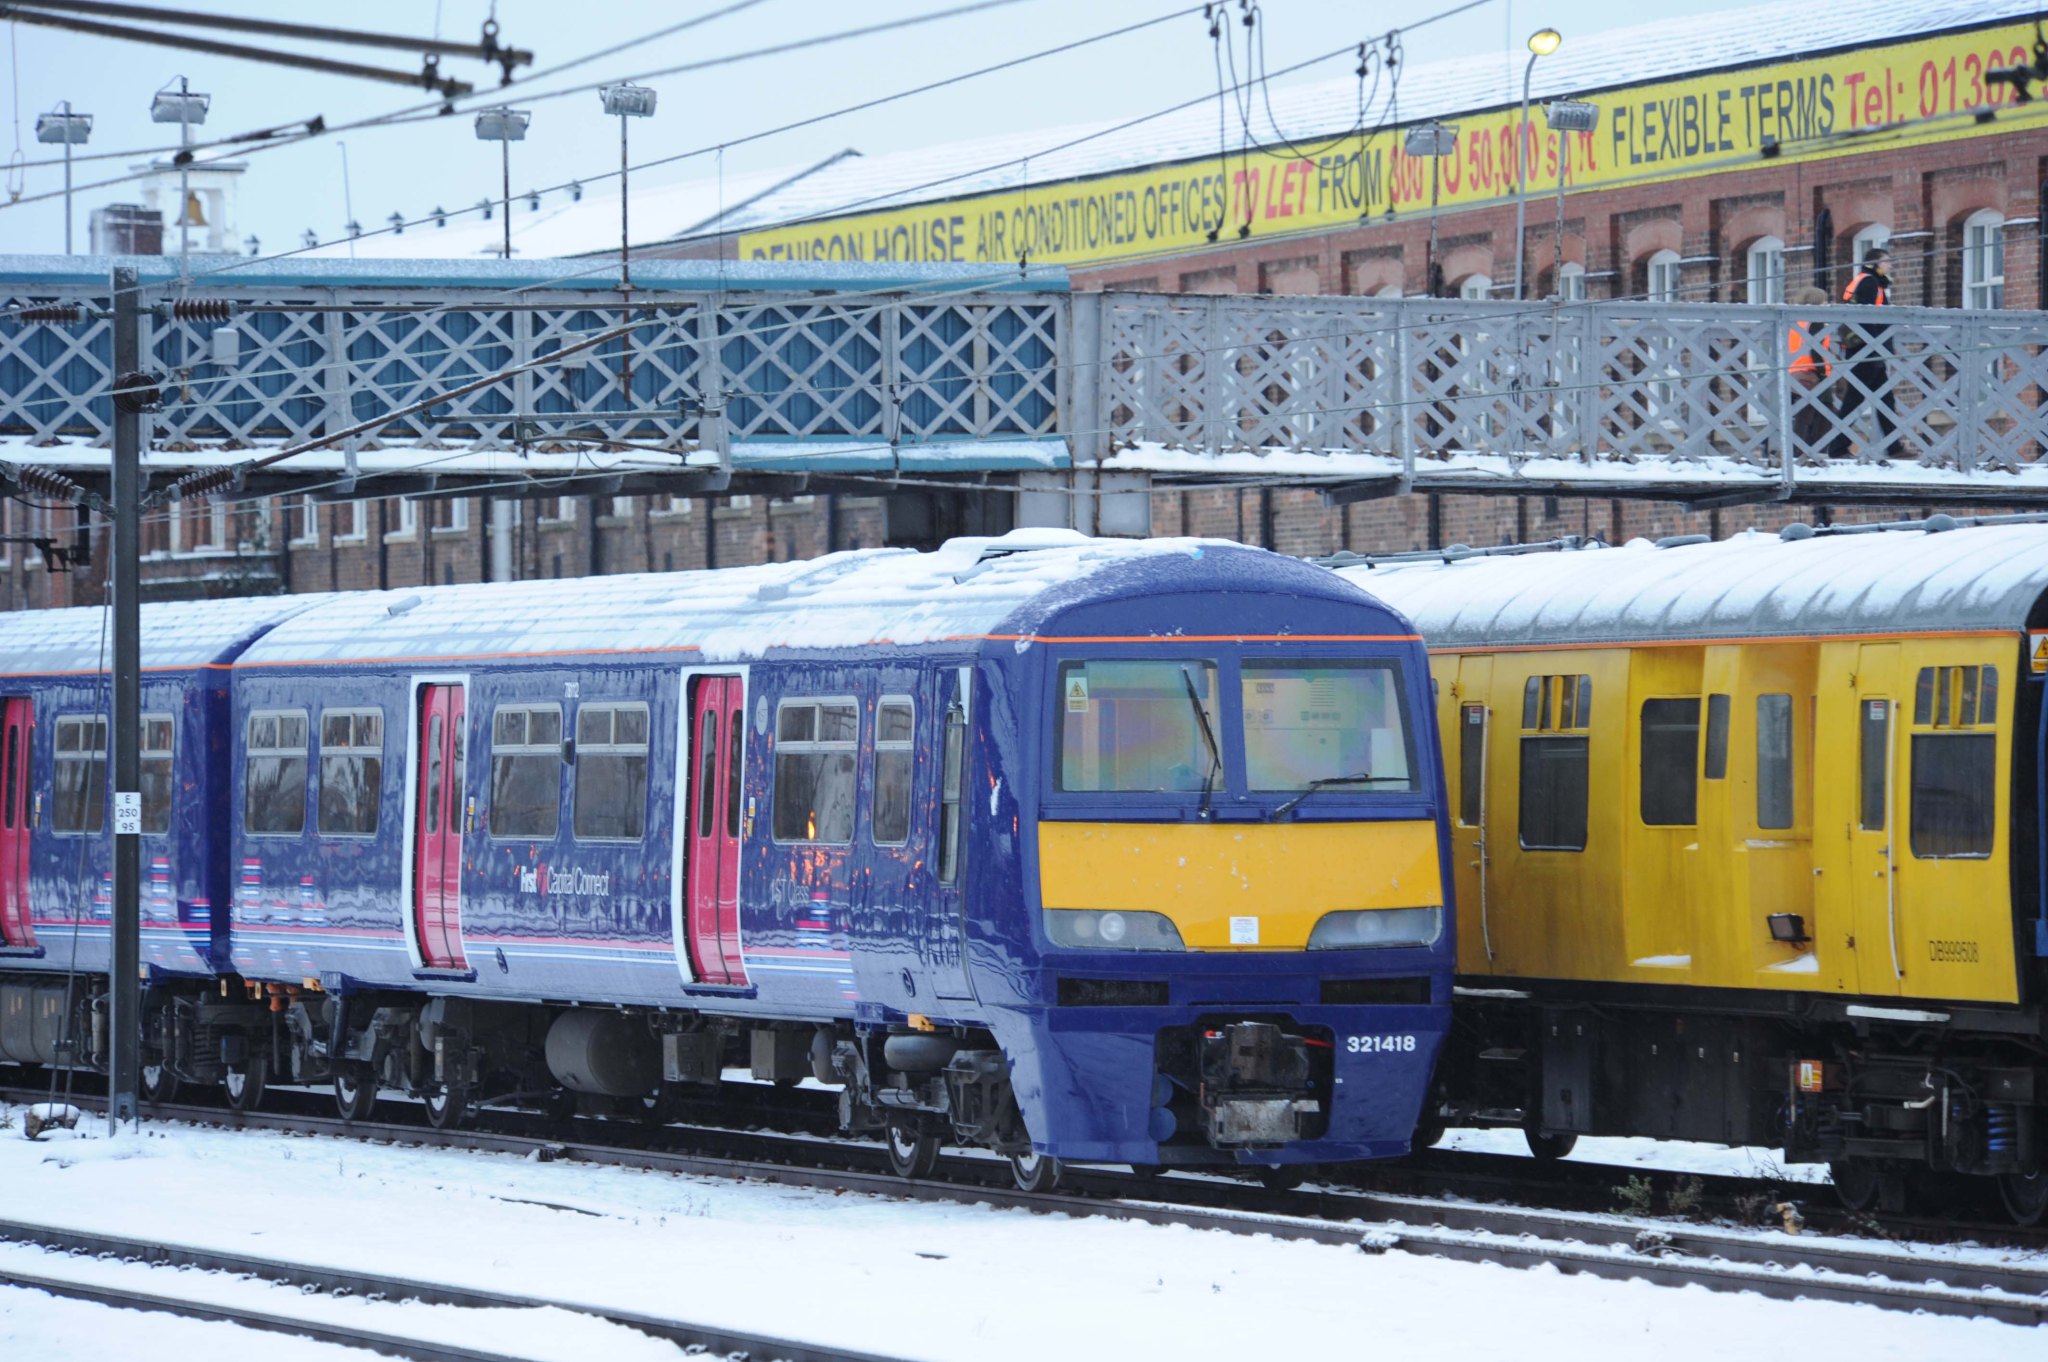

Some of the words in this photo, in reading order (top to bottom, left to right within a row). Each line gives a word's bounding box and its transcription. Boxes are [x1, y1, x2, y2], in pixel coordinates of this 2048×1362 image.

[874, 216, 965, 262] HOUSE
[977, 210, 1006, 262] AIR
[1011, 190, 1137, 258] CONDITIONED
[1143, 173, 1226, 240] OFFICES
[1233, 168, 1260, 224] TO
[1265, 158, 1314, 220] LET
[1318, 148, 1383, 213] FROM
[1612, 89, 1735, 168] FLEXIBLE
[1740, 73, 1835, 149] TERMS
[1844, 67, 1905, 128] Tel:
[125, 794, 131, 804] E
[118, 808, 138, 818] 250
[121, 822, 135, 832] 95
[520, 865, 538, 894] First
[547, 865, 575, 900] Capital
[575, 866, 610, 897] Connect
[1346, 1034, 1417, 1053] 321418
